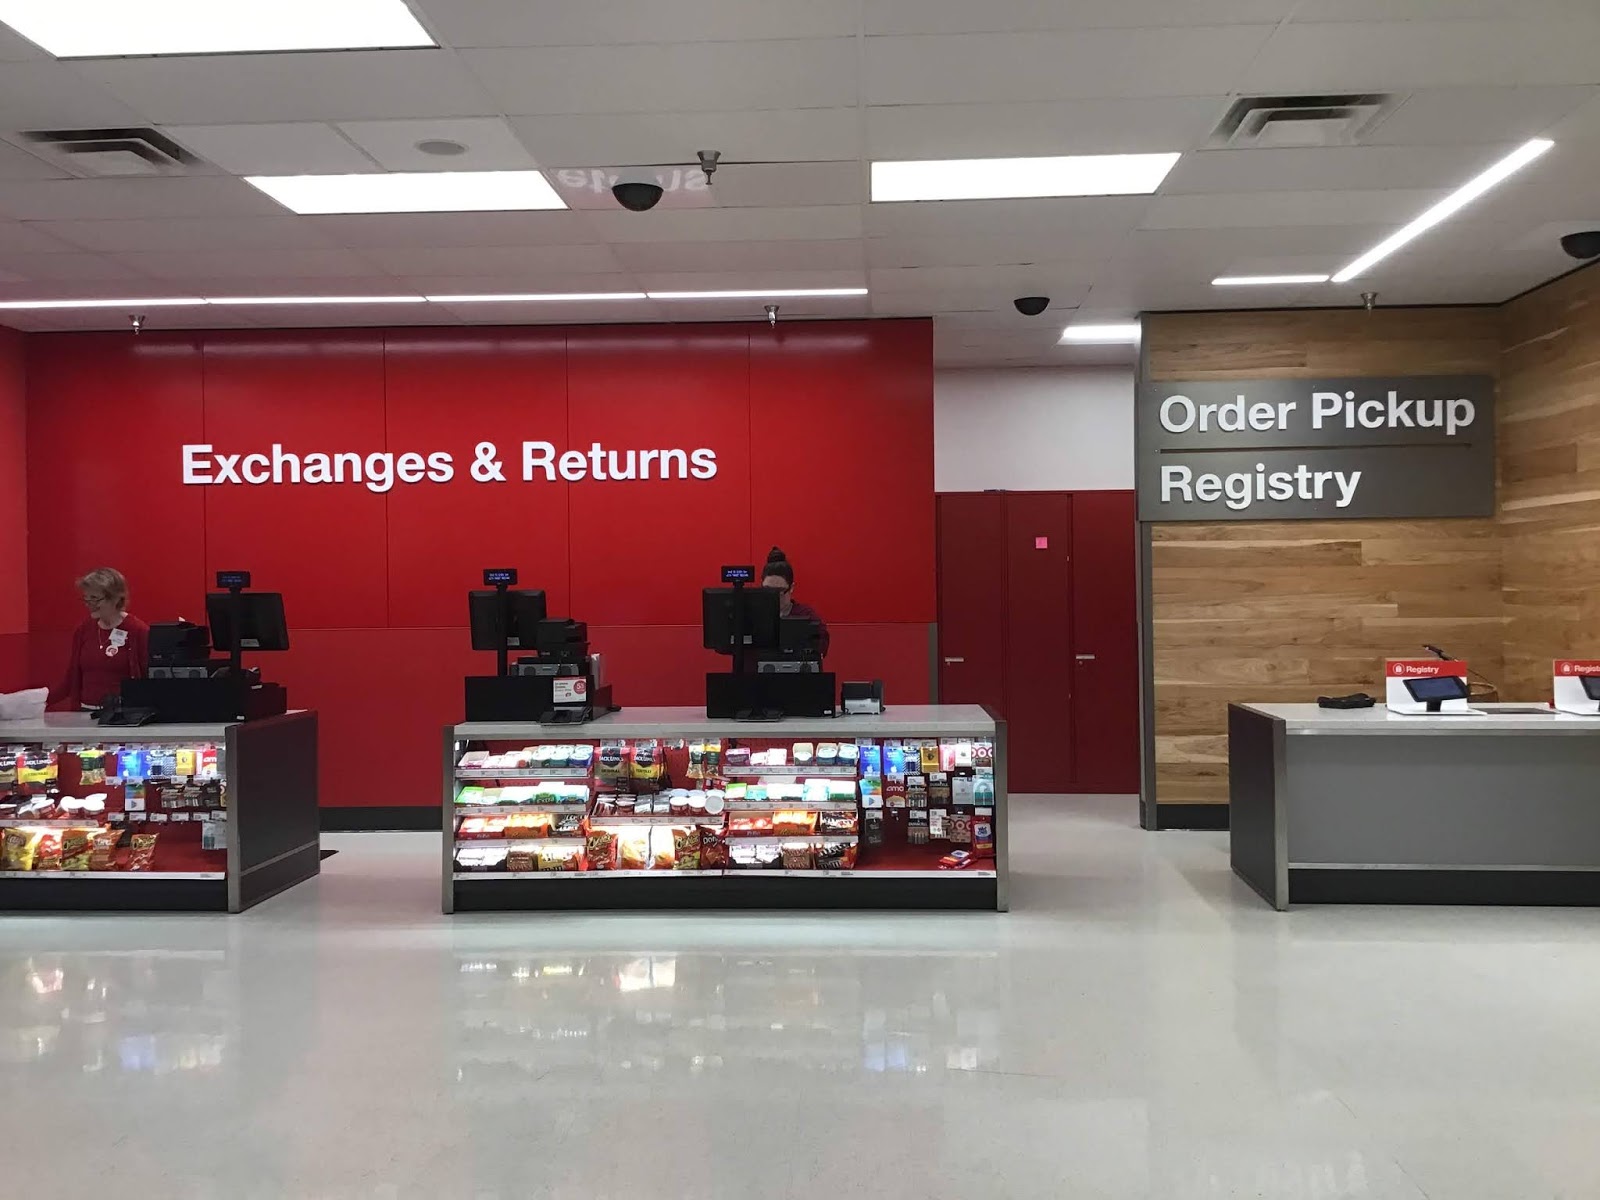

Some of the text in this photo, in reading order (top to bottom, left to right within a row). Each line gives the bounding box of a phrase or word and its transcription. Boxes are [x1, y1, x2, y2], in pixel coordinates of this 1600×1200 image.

[1159, 390, 1475, 435] Order Pickup
[181, 441, 718, 493] Exchanges & Returns
[1160, 462, 1362, 510] Registry
[1406, 665, 1440, 675] Registry
[1574, 664, 1600, 674] Regist
